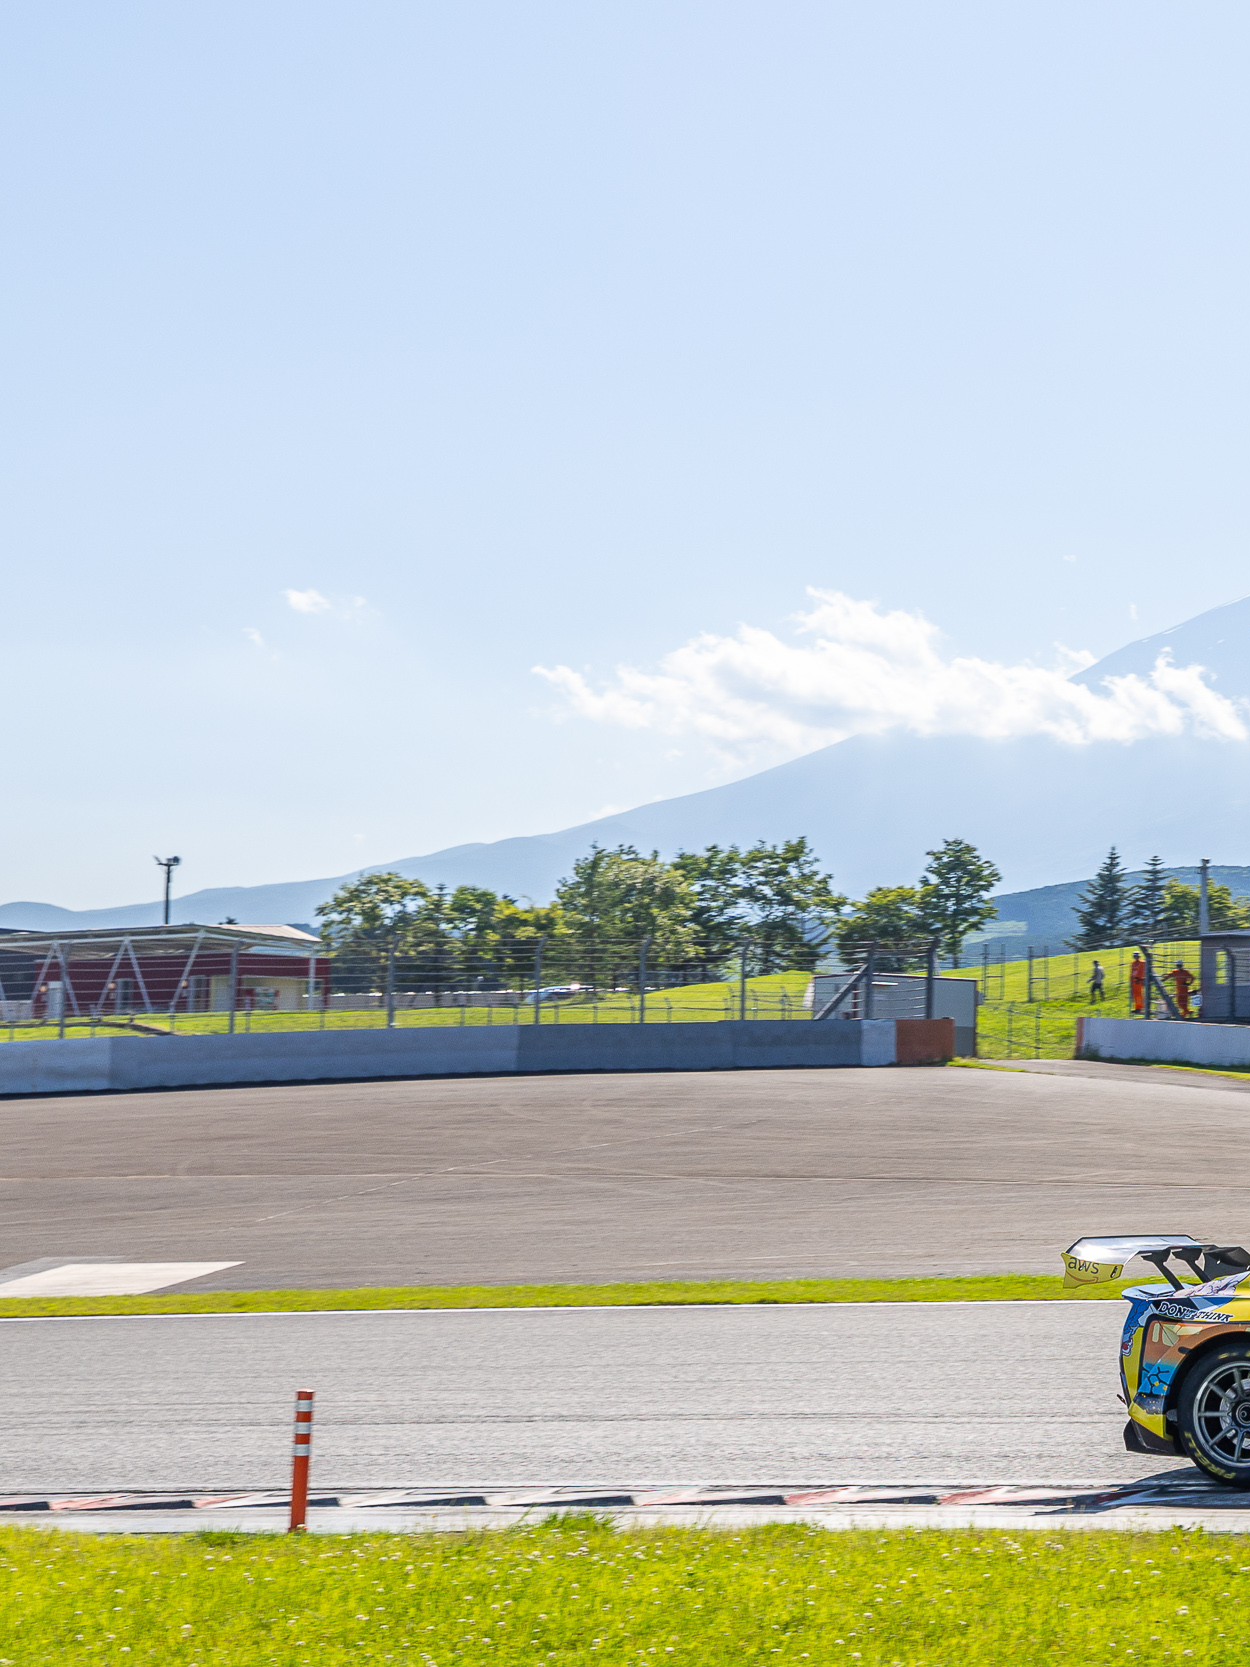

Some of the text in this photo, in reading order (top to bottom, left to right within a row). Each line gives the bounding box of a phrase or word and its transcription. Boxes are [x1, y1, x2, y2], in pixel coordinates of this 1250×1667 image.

[1068, 1257, 1100, 1275] aws
[1158, 1301, 1235, 1323] DON'T THINK
